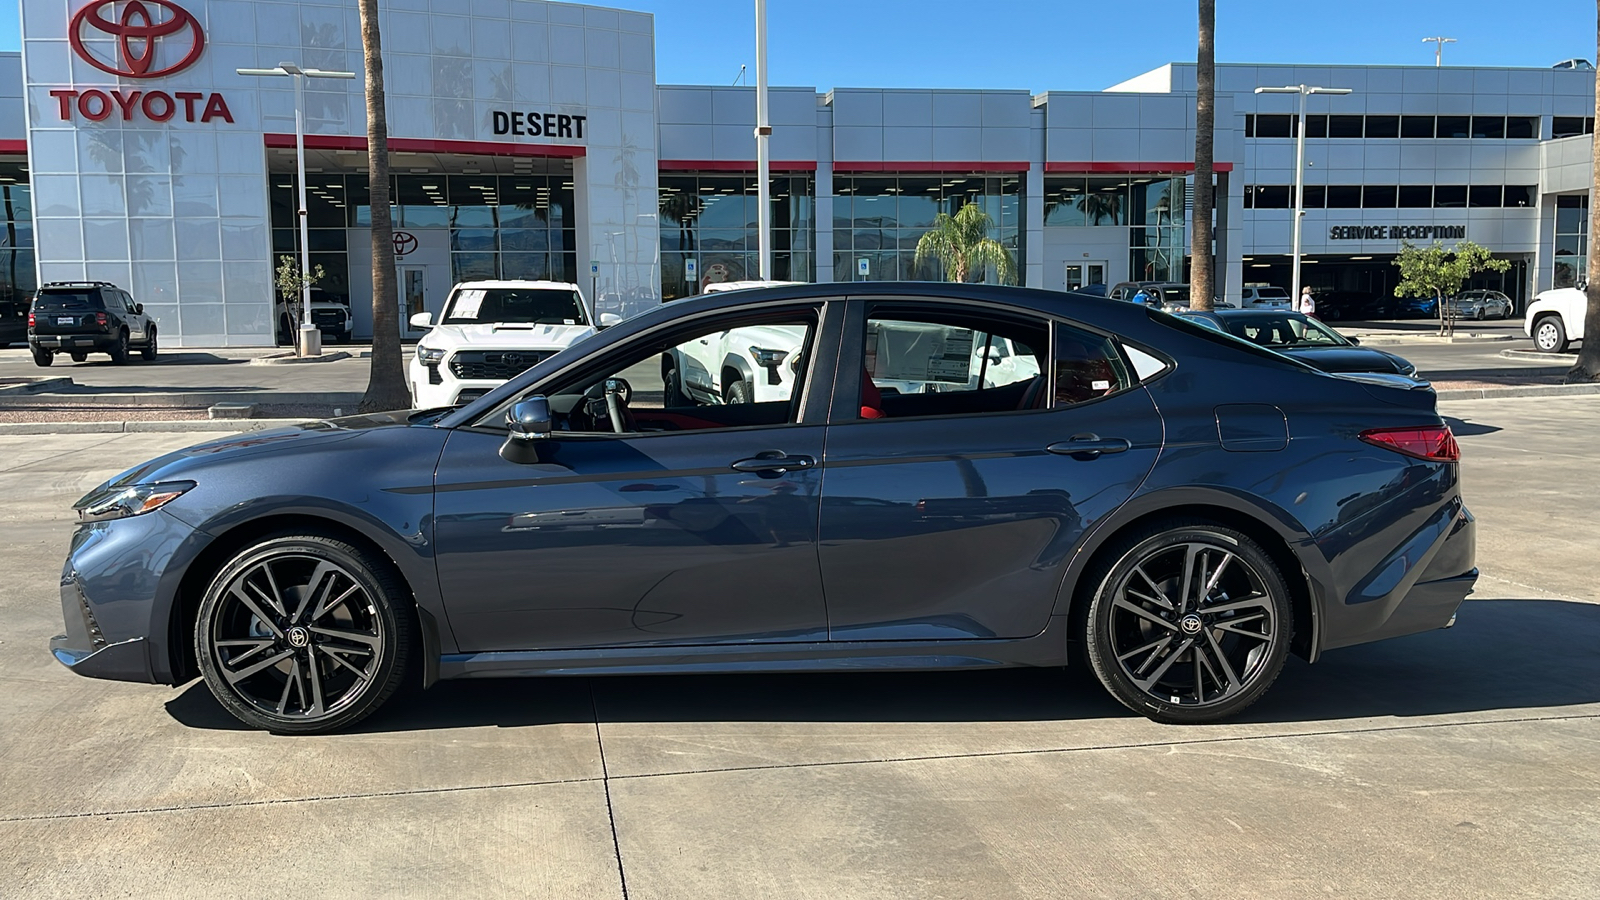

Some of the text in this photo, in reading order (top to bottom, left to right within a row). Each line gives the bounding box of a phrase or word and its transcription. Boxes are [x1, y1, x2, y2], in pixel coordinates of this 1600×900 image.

[50, 89, 234, 123] TOYOTA
[493, 111, 587, 138] DESERT
[1330, 225, 1466, 240] SERVICE RECEPTION
